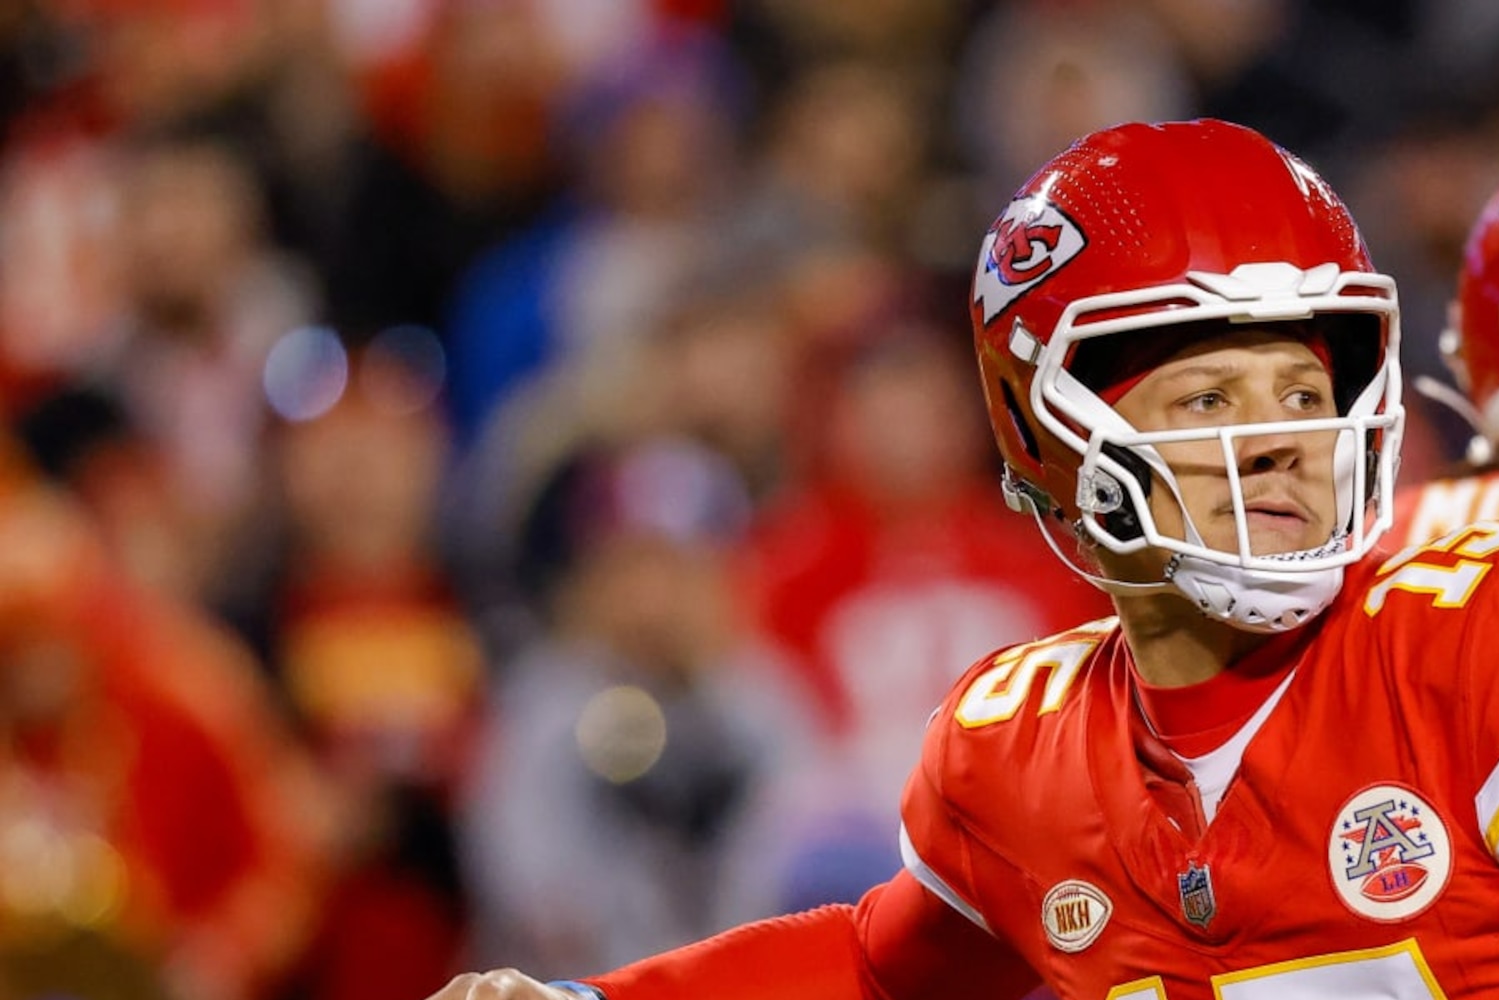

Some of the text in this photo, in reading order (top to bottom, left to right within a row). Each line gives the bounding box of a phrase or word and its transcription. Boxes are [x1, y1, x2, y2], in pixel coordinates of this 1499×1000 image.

[1345, 799, 1436, 881] A
[1381, 871, 1410, 893] LH
[1055, 899, 1091, 934] NKH
